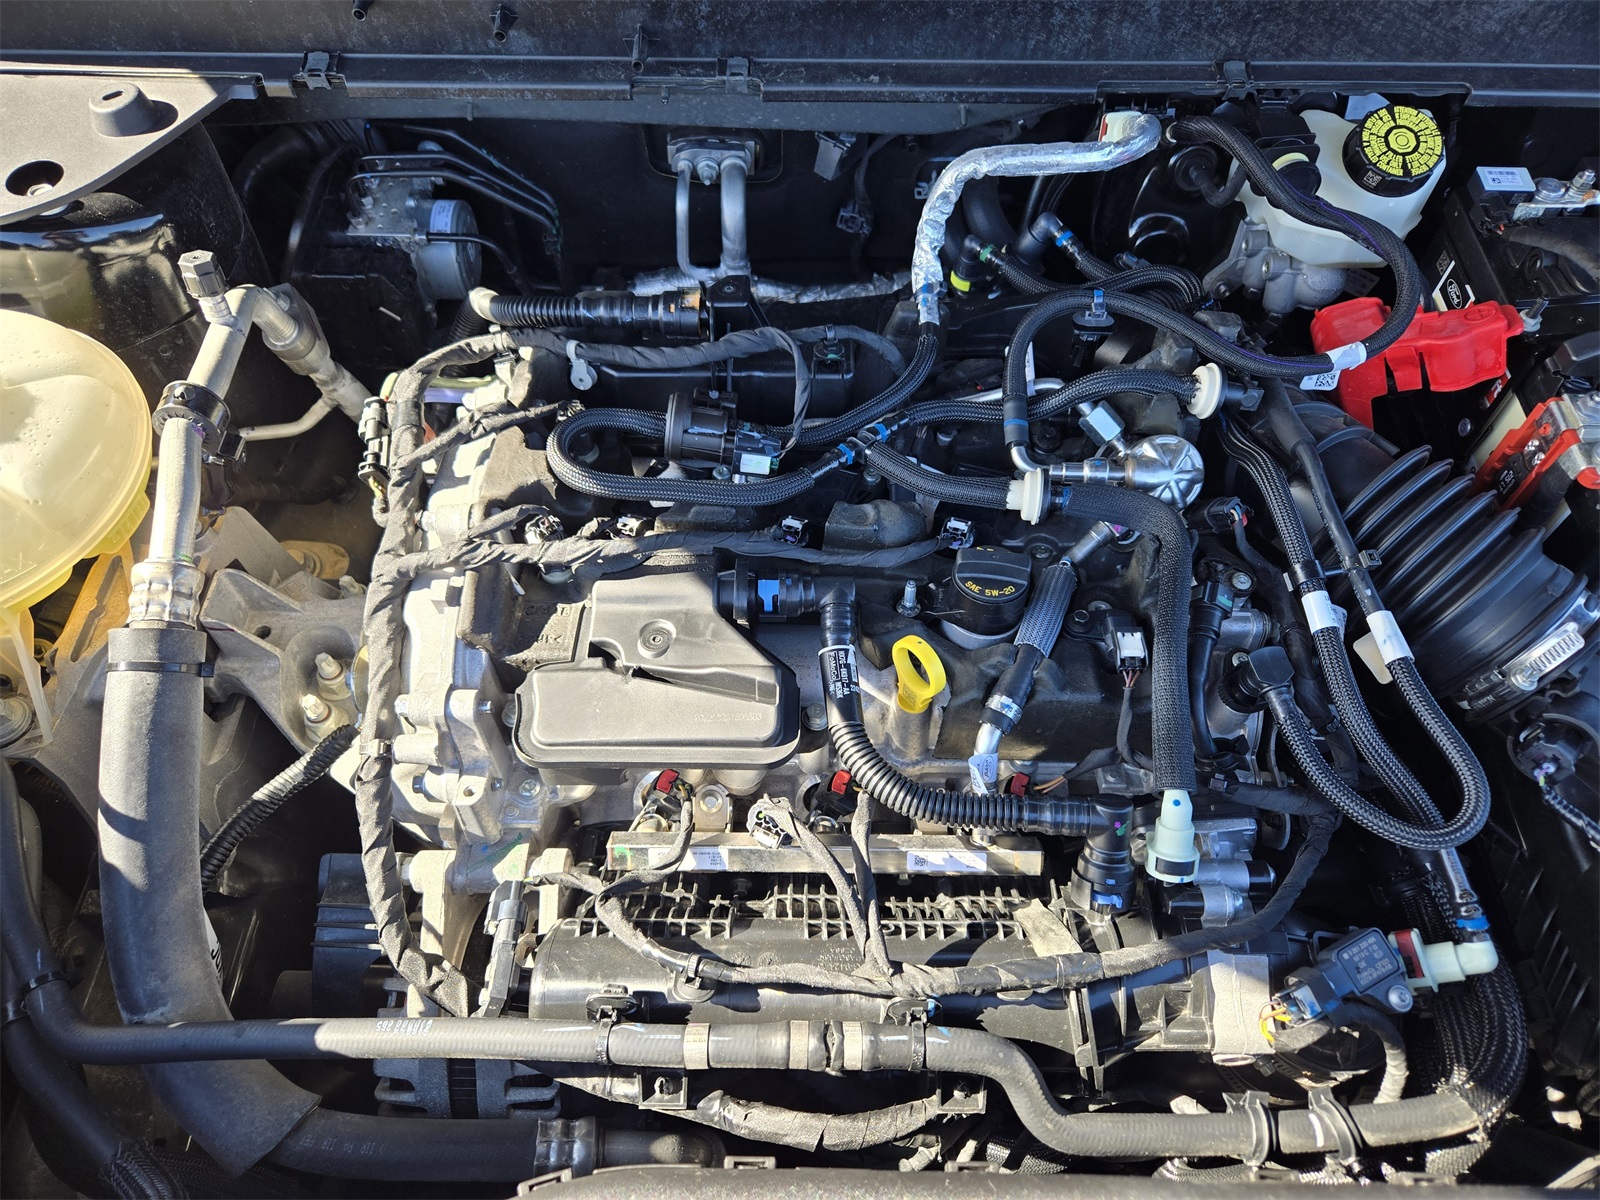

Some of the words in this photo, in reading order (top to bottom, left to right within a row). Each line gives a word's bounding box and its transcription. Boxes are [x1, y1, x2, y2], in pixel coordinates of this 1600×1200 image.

[965, 581, 982, 593] SAE
[985, 585, 1015, 597] 5W-20
[827, 651, 837, 679] FoMoCo
